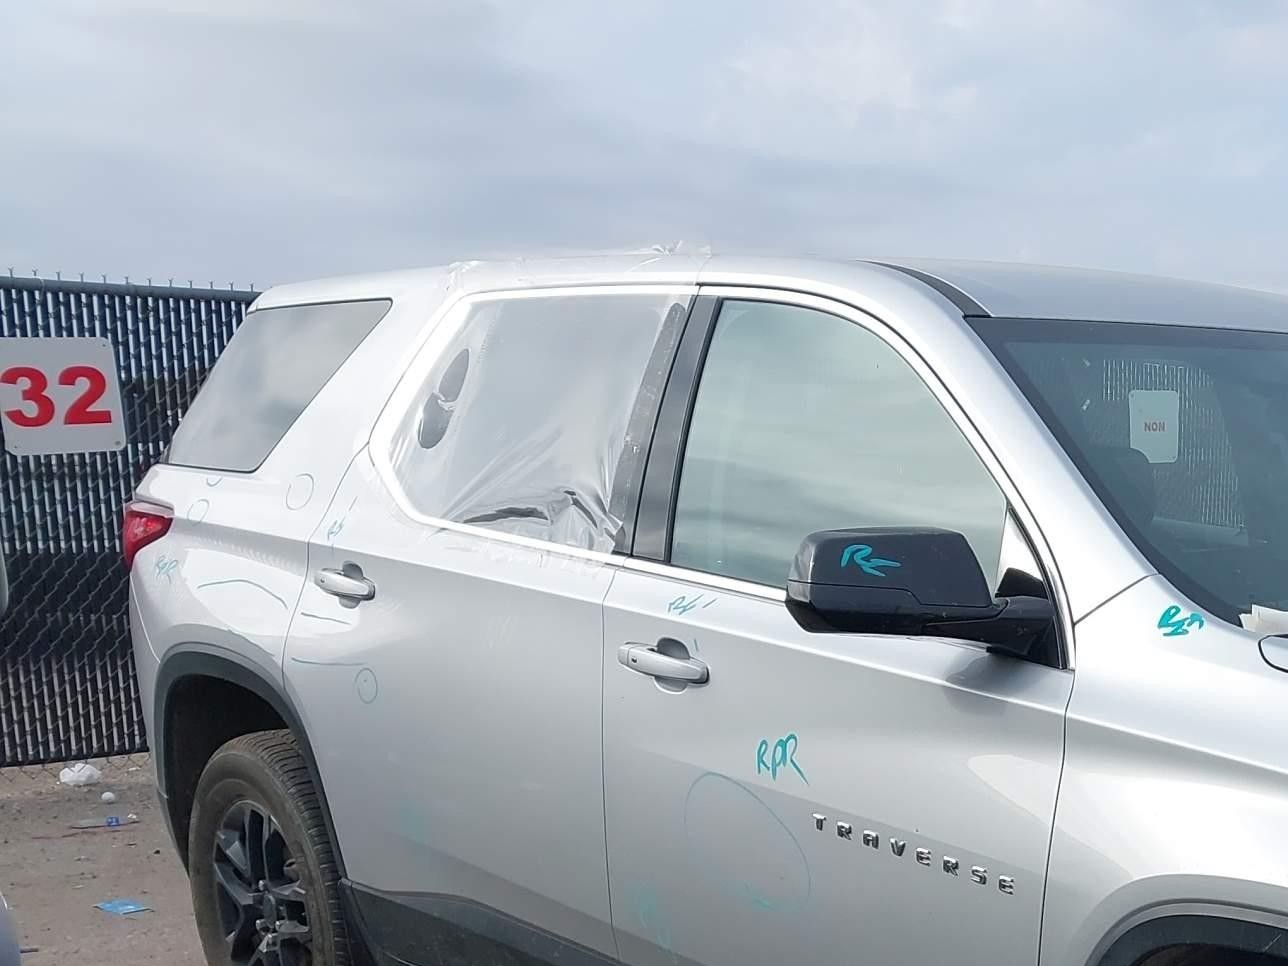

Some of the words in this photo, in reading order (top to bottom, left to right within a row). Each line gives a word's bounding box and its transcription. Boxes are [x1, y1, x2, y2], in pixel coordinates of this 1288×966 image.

[0, 365, 112, 428] 32
[1143, 421, 1167, 433] NON
[812, 812, 1016, 896] TRAVERSE
